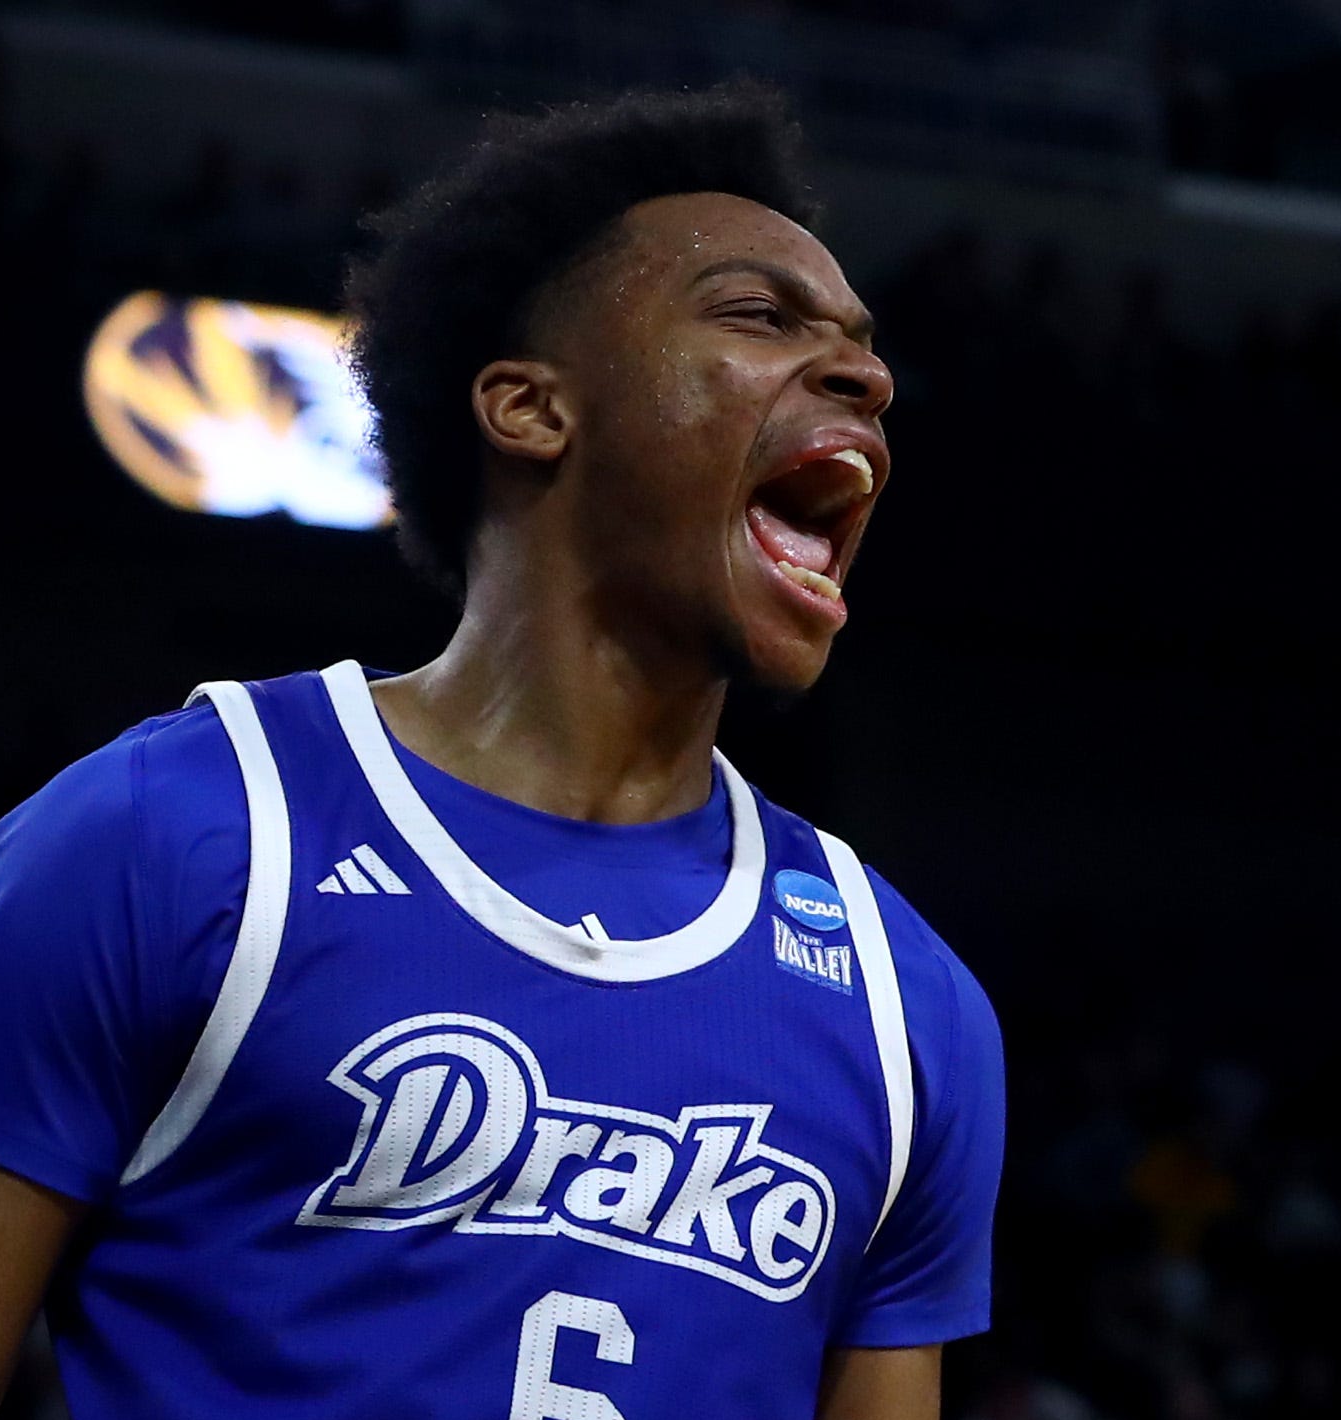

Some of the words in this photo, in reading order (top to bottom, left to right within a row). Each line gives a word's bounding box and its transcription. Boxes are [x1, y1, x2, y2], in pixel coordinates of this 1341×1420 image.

[784, 893, 846, 920] NCAA
[771, 914, 852, 987] VALLEY
[294, 1012, 836, 1303] Drake
